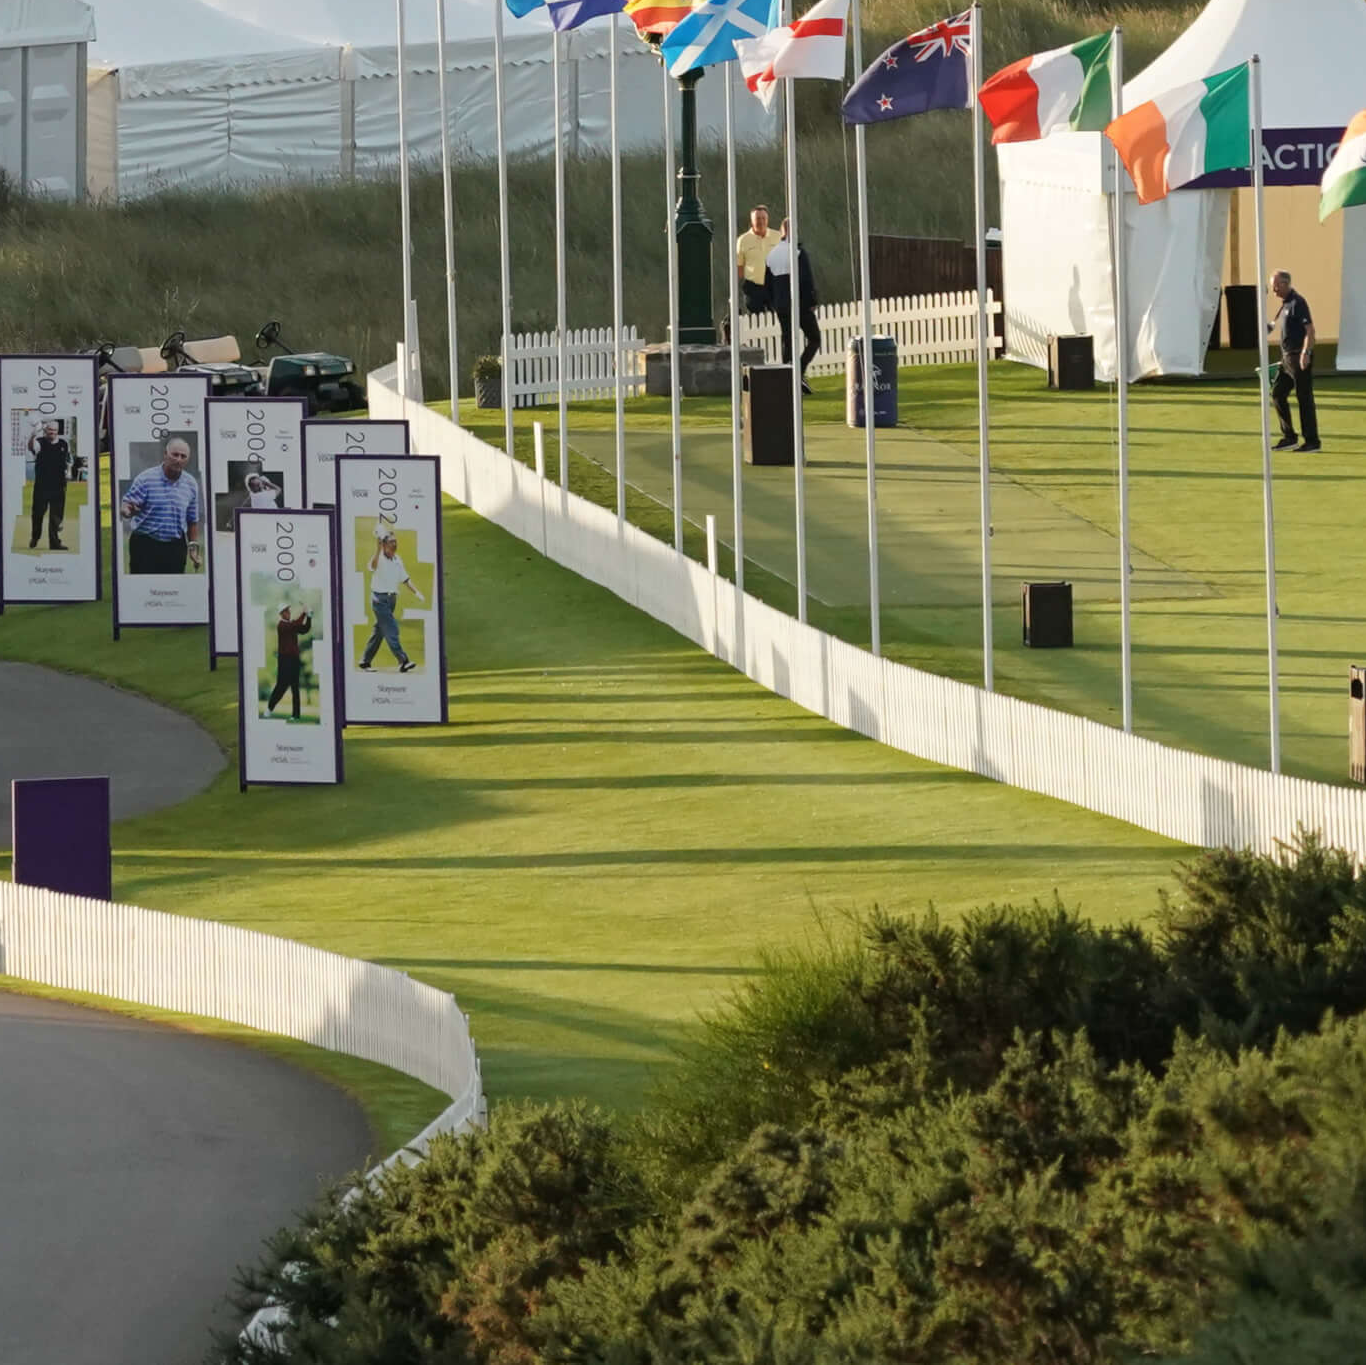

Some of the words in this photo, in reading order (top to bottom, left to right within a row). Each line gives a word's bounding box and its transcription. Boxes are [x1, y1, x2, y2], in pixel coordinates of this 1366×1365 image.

[37, 365, 57, 415] 2010
[150, 385, 170, 439] 2008
[378, 468, 398, 524] 2002
[276, 522, 295, 581] 2000
